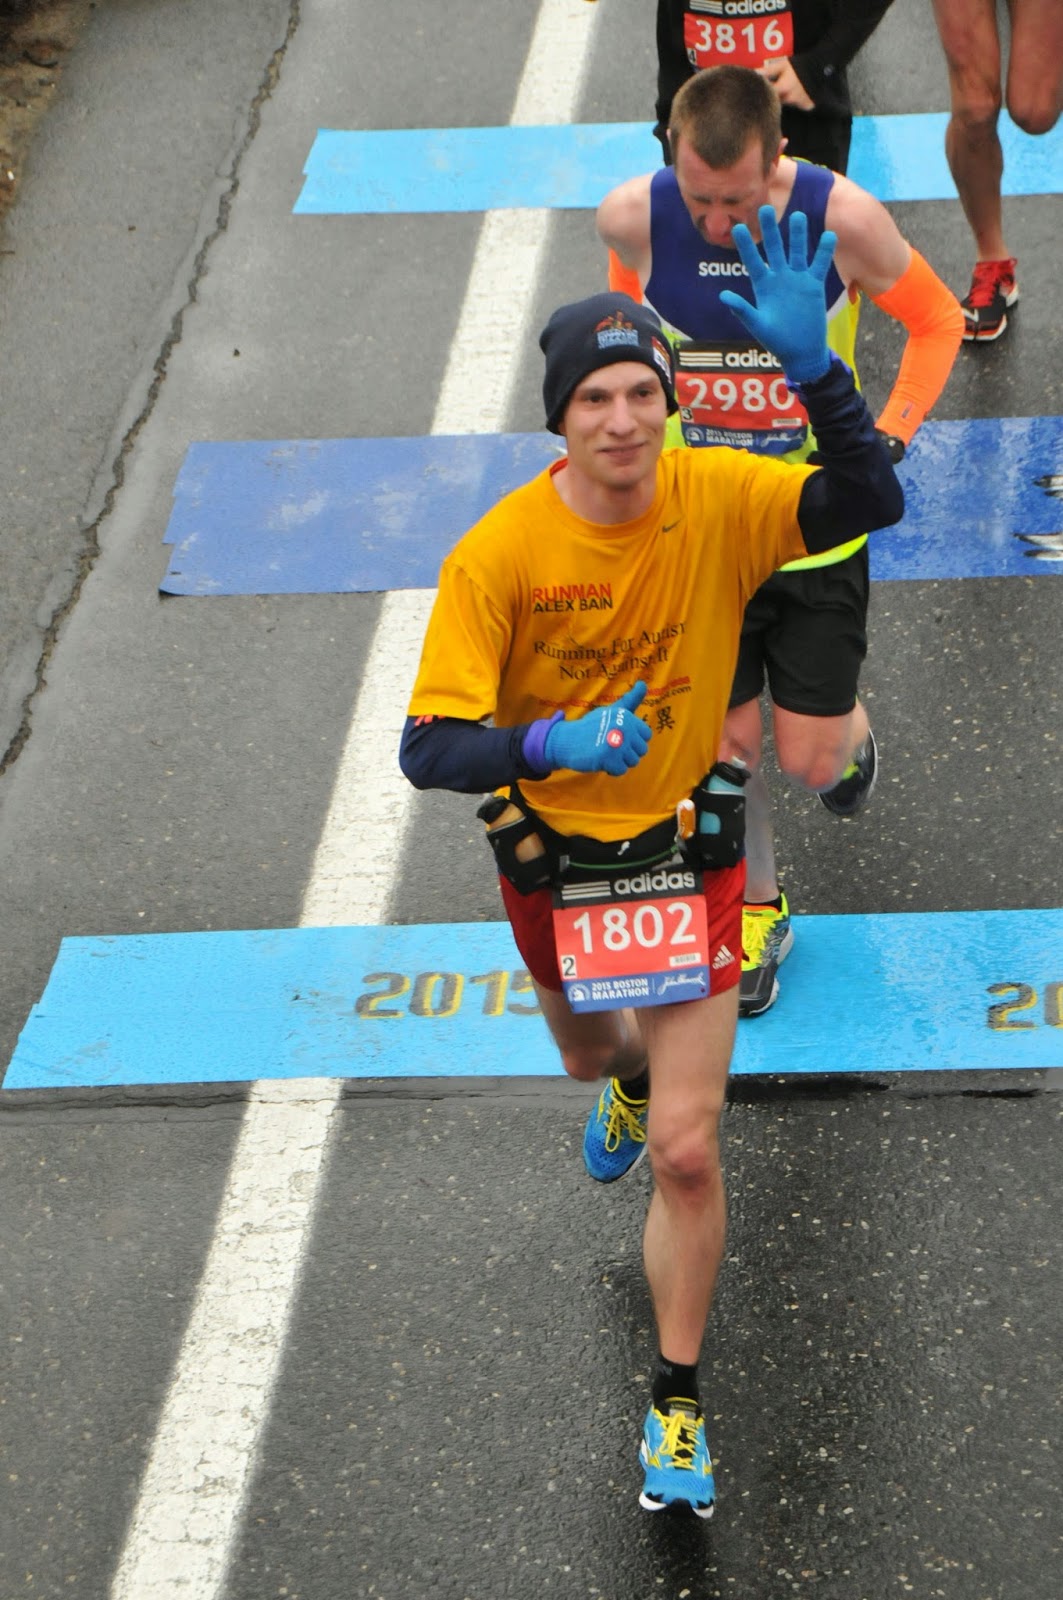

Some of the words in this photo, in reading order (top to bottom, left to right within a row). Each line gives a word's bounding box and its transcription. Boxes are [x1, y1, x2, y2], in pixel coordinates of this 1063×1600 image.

[724, 0, 787, 15] adidas
[694, 19, 784, 53] 3816
[698, 261, 770, 277] sauc
[725, 349, 782, 368] adid
[685, 377, 796, 412] 2980
[682, 408, 693, 420] 3
[532, 583, 612, 603] RUNMAN
[533, 600, 575, 613] ALEX
[580, 597, 613, 611] BAIN
[534, 641, 608, 664] Running
[610, 637, 634, 655] For
[559, 666, 591, 681] Not
[614, 871, 695, 895] adidas
[573, 902, 697, 954] 1802
[562, 957, 576, 977] 2
[592, 981, 612, 991] 2015
[613, 977, 648, 989] BOSTON
[592, 986, 650, 1000] MARATHON
[355, 970, 544, 1019] 2015
